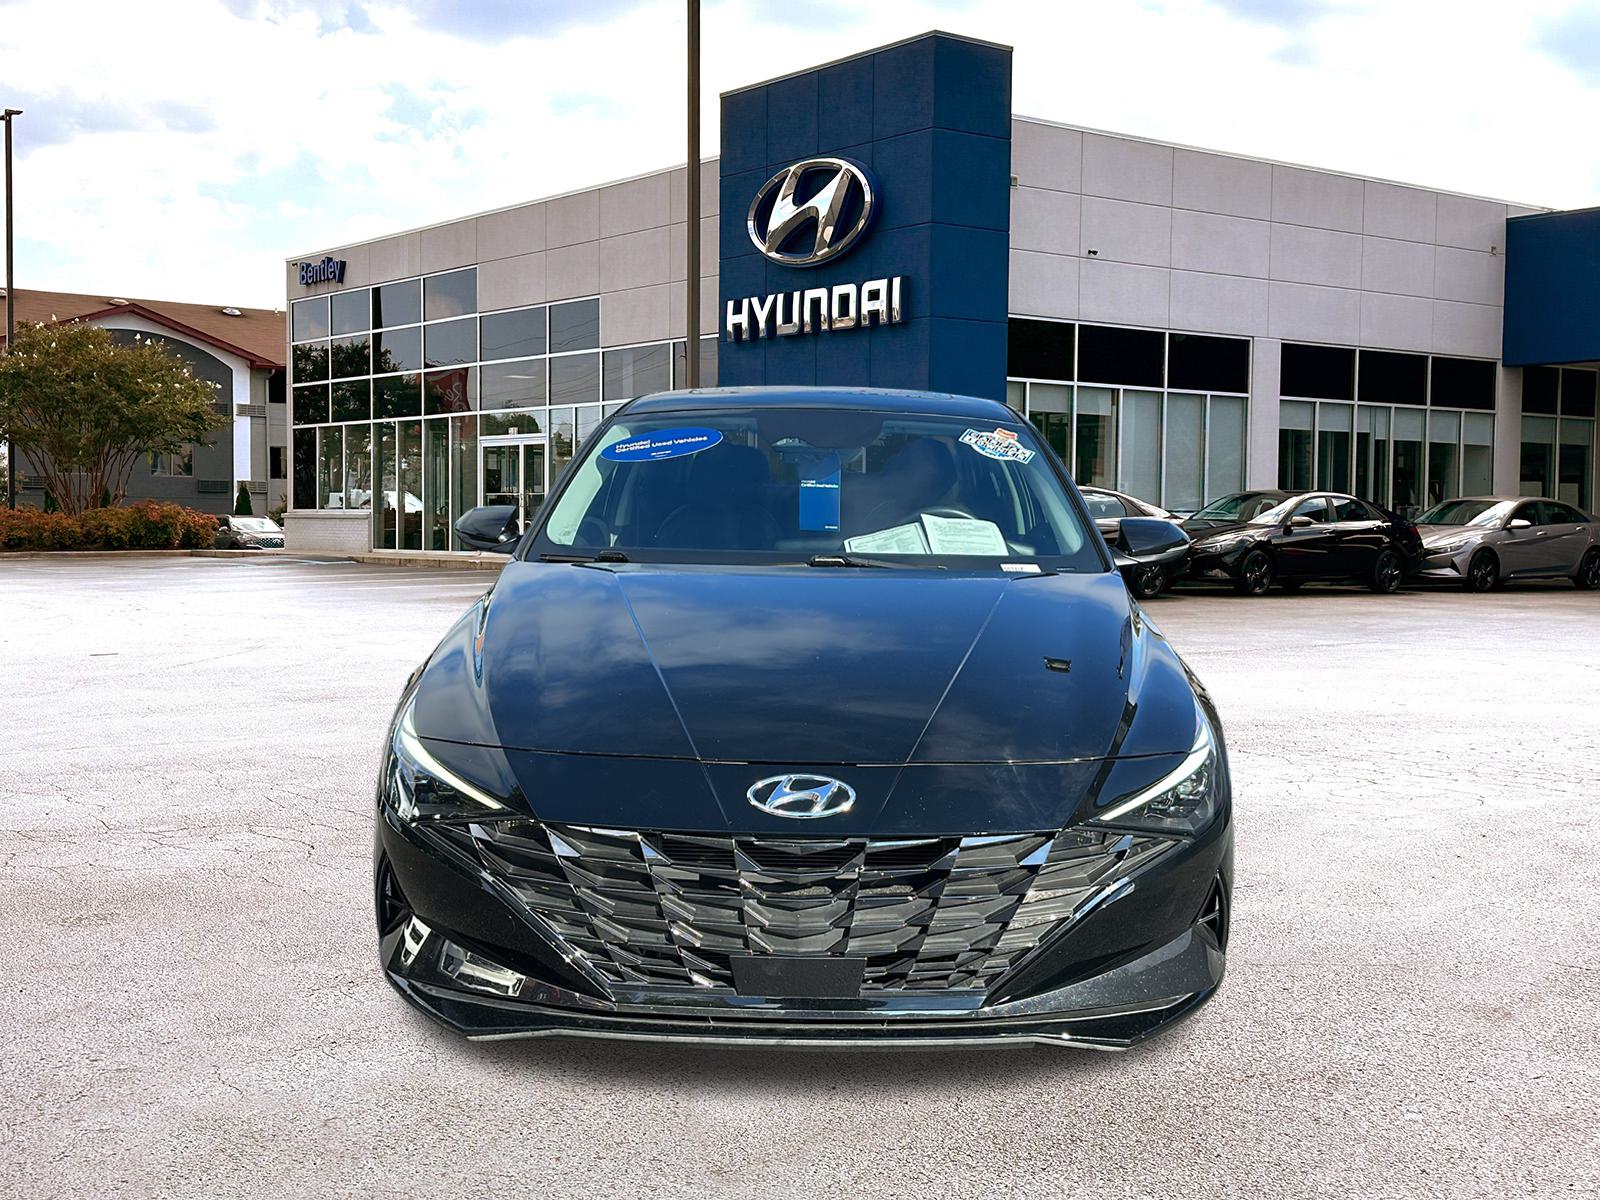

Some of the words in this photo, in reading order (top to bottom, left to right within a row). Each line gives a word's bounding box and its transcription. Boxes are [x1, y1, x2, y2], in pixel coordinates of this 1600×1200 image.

[300, 257, 345, 285] Bentley
[726, 276, 903, 342] HYUNDAI
[651, 440, 673, 448] Used
[673, 436, 708, 445] Vehicles
